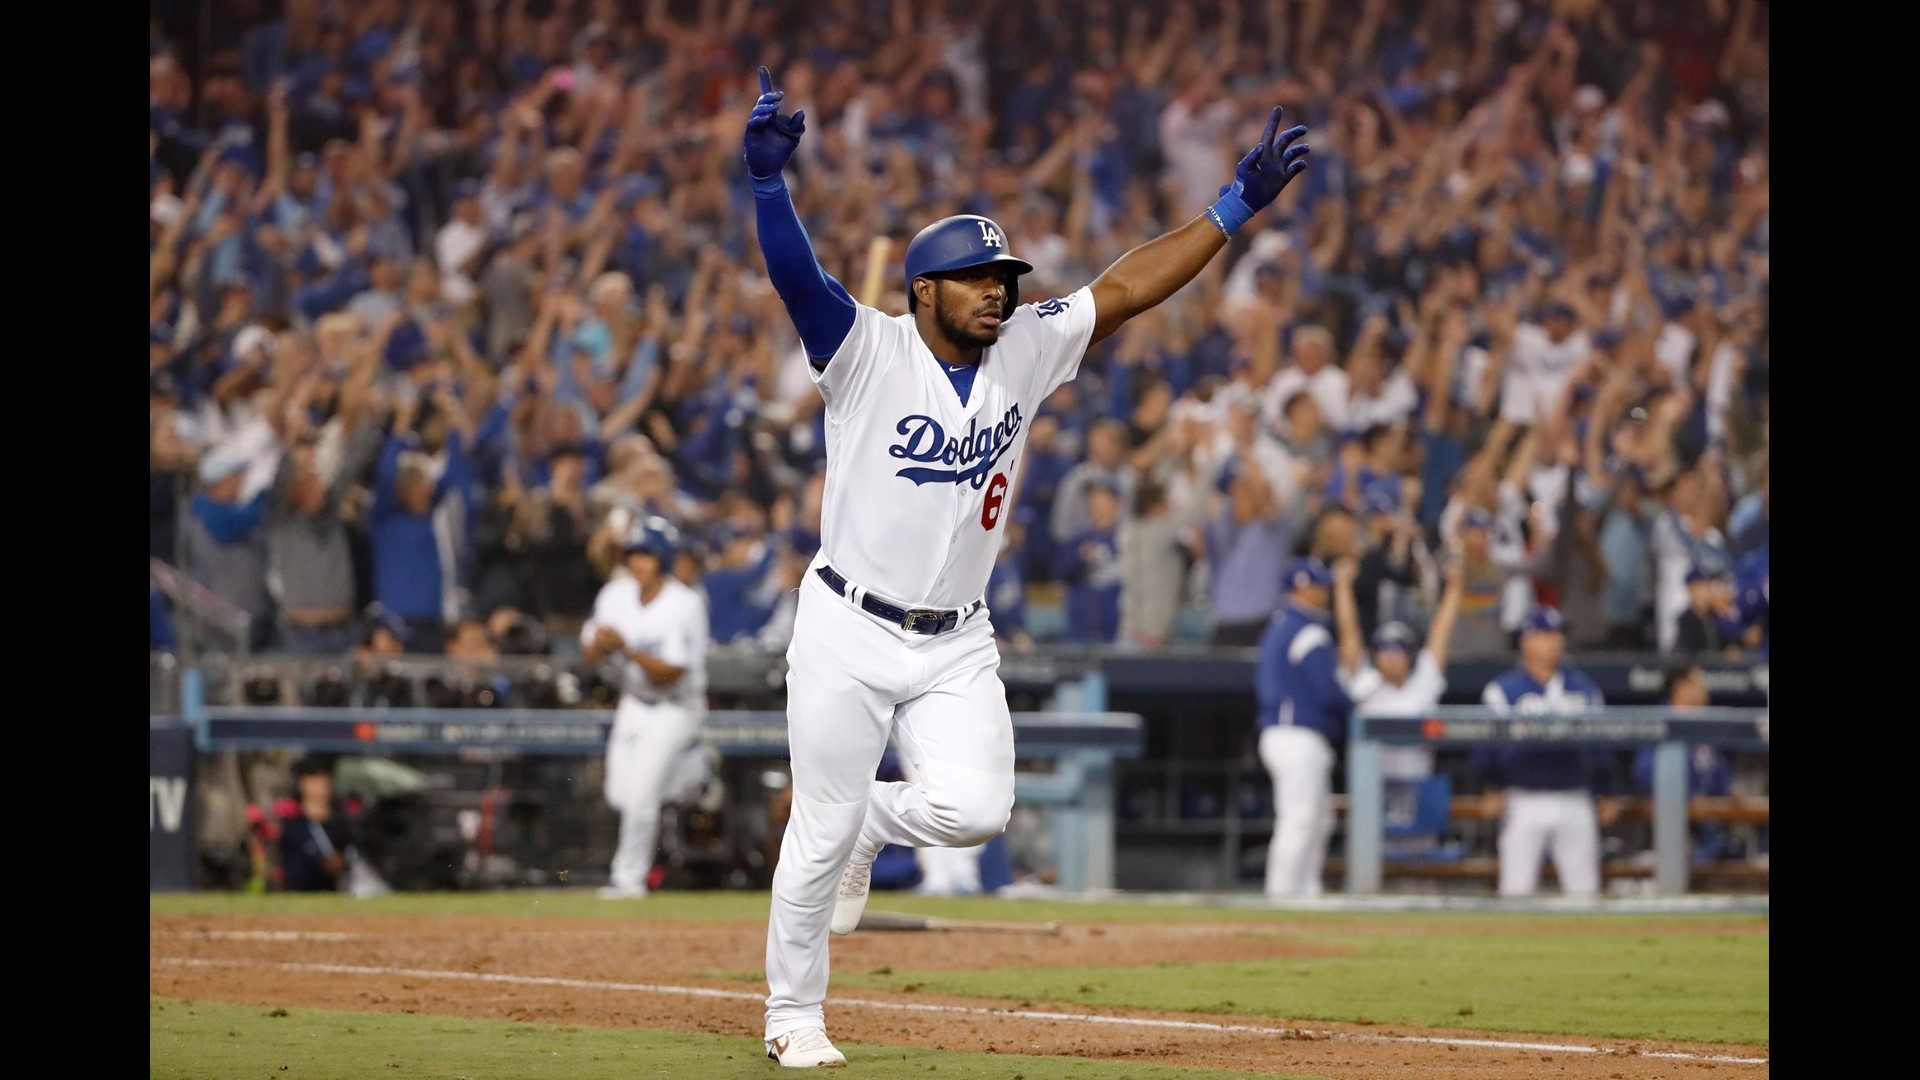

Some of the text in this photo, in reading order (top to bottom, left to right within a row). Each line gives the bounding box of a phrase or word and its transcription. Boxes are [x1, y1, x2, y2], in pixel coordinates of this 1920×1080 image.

[978, 221, 1002, 248] LA
[889, 402, 1022, 490] Dodgers
[981, 471, 1009, 531] 6
